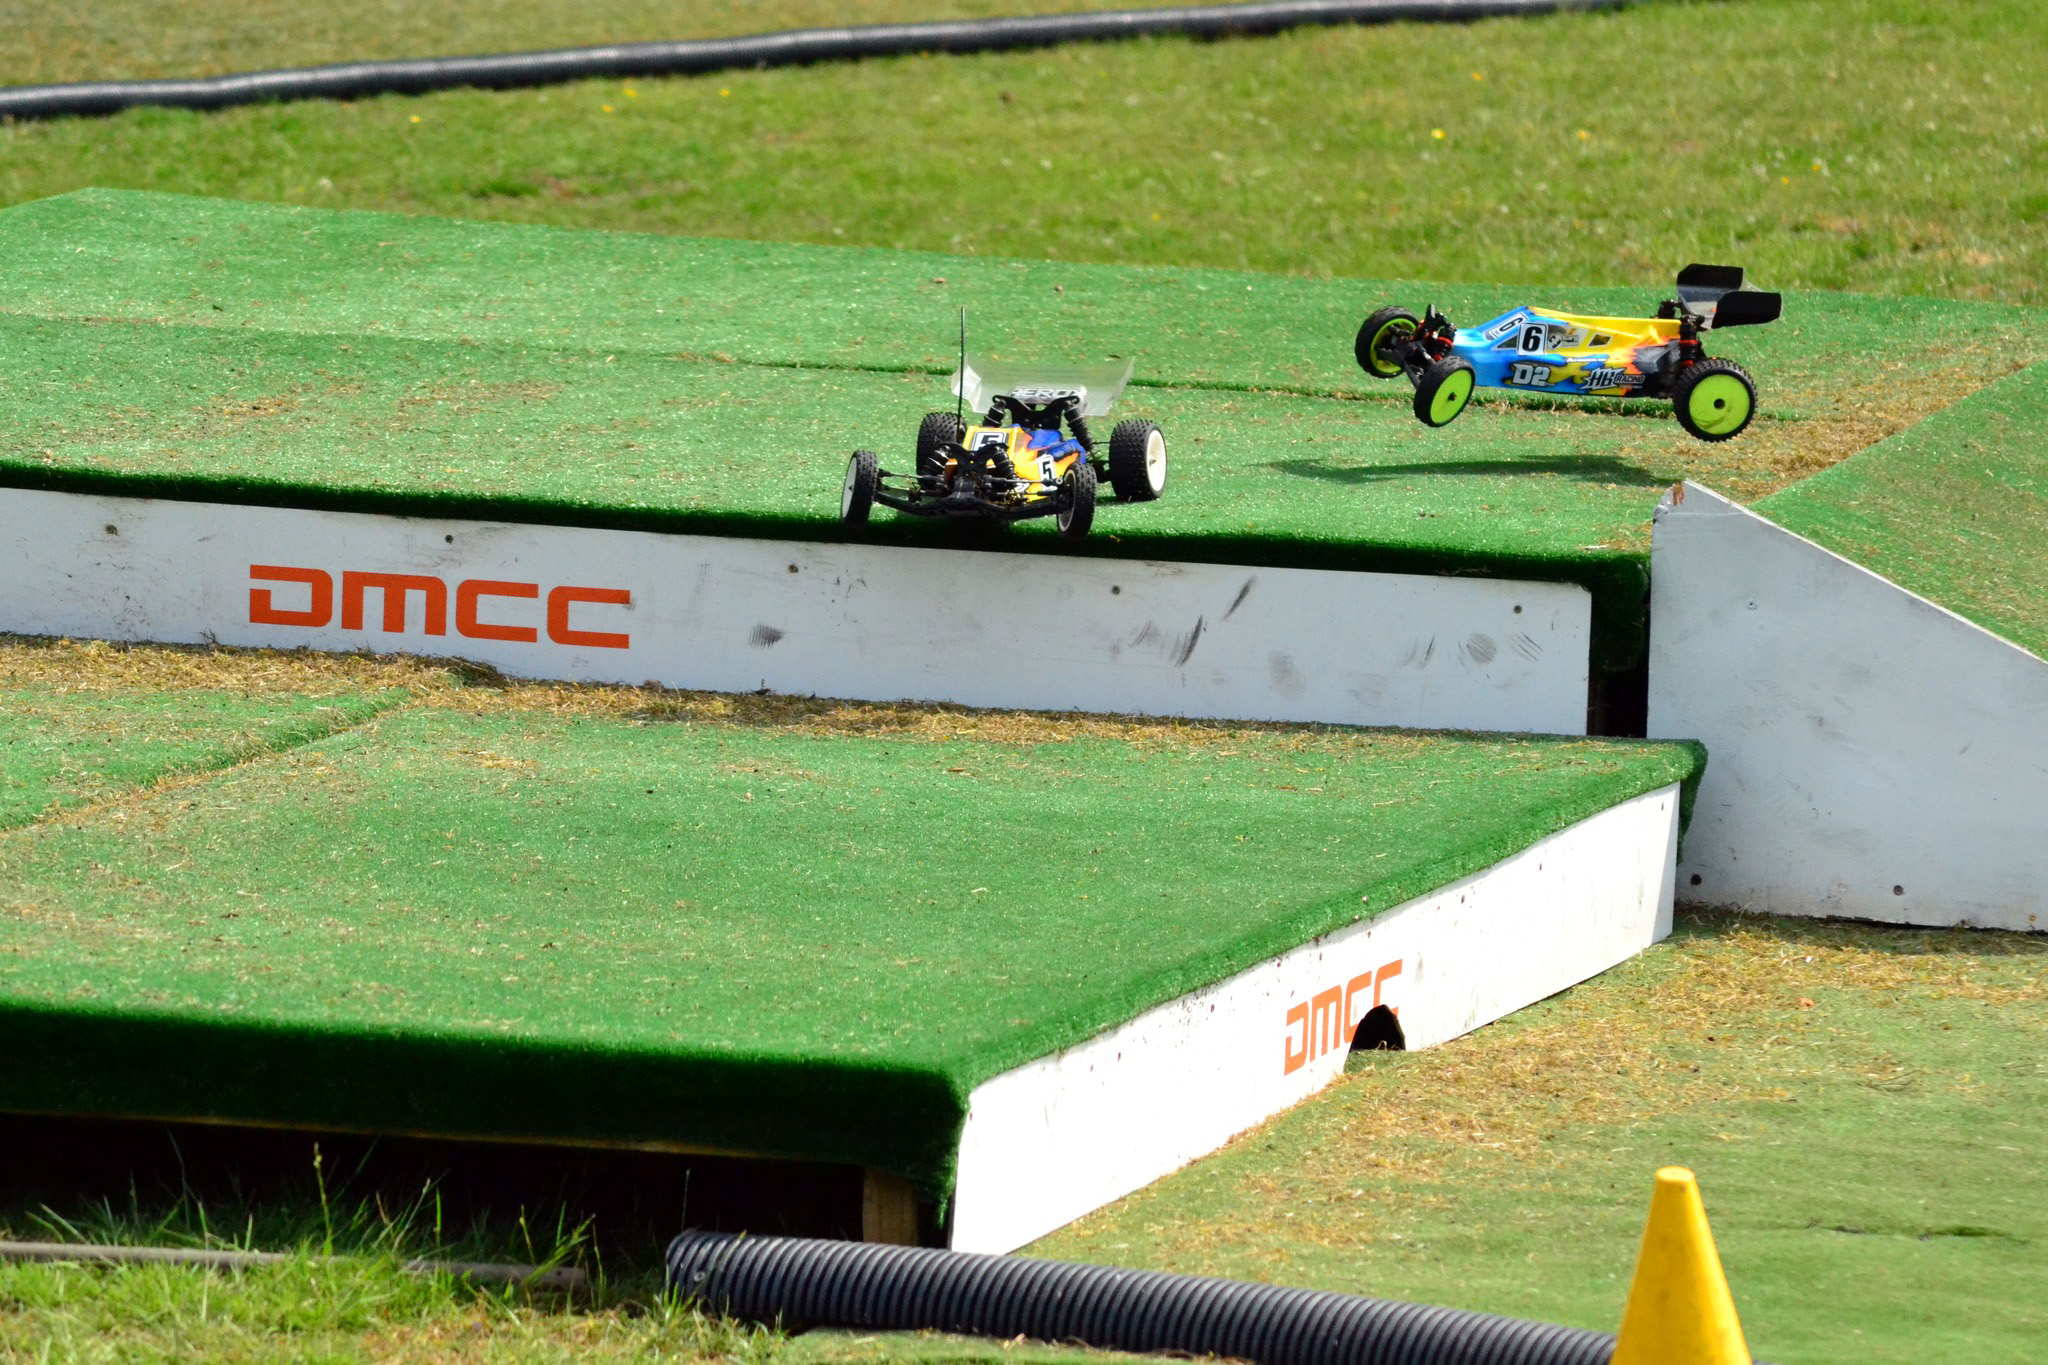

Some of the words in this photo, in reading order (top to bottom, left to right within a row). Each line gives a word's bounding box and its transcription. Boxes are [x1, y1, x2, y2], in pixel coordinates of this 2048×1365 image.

[1499, 317, 1524, 332] 6
[1521, 326, 1543, 352] 6
[1512, 363, 1551, 387] D2
[1041, 460, 1054, 480] 5
[249, 564, 631, 649] DMCC
